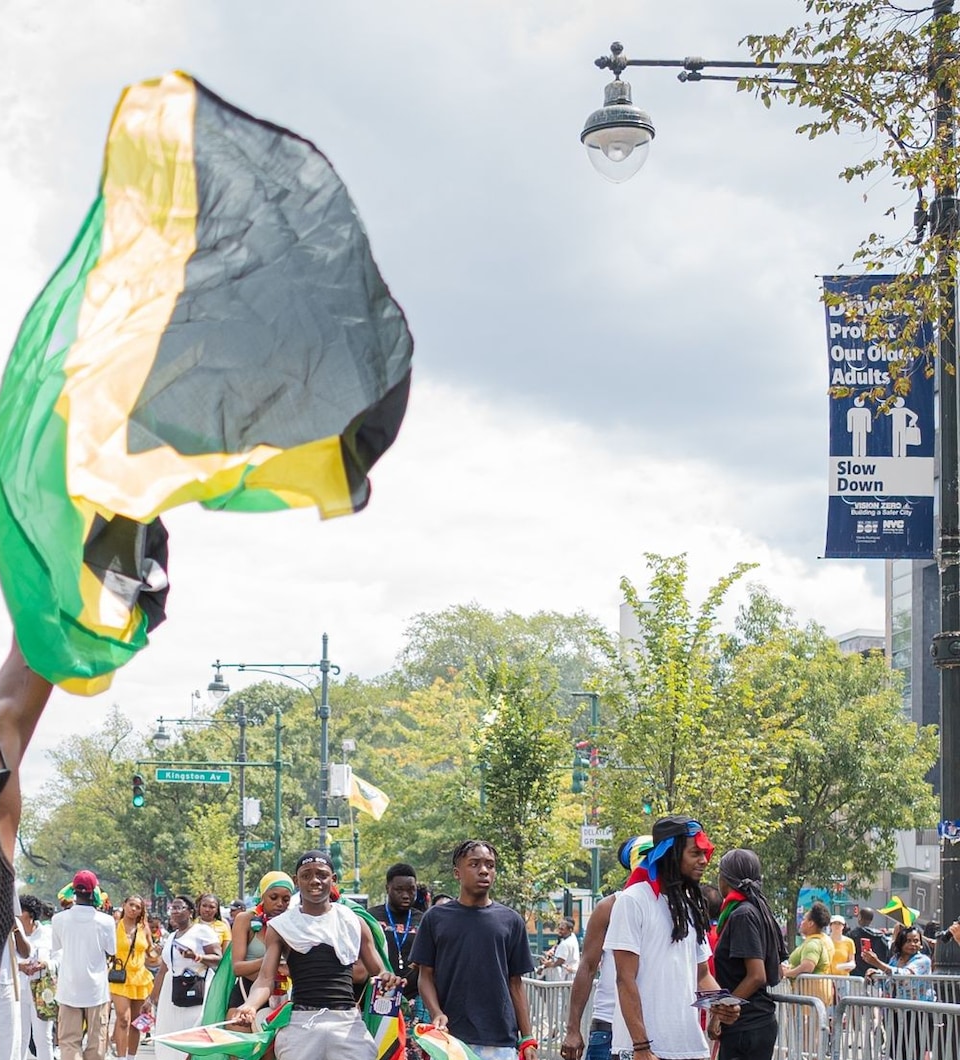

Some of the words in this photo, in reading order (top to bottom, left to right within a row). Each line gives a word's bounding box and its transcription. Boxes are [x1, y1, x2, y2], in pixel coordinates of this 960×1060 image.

[829, 322, 897, 339] Prott
[830, 345, 865, 362] Our
[831, 368, 891, 385] Adults
[837, 460, 877, 476] Slow
[837, 477, 884, 492] Down
[854, 501, 880, 509] VISION
[881, 501, 902, 509] ZERO
[165, 771, 205, 781] Kingston
